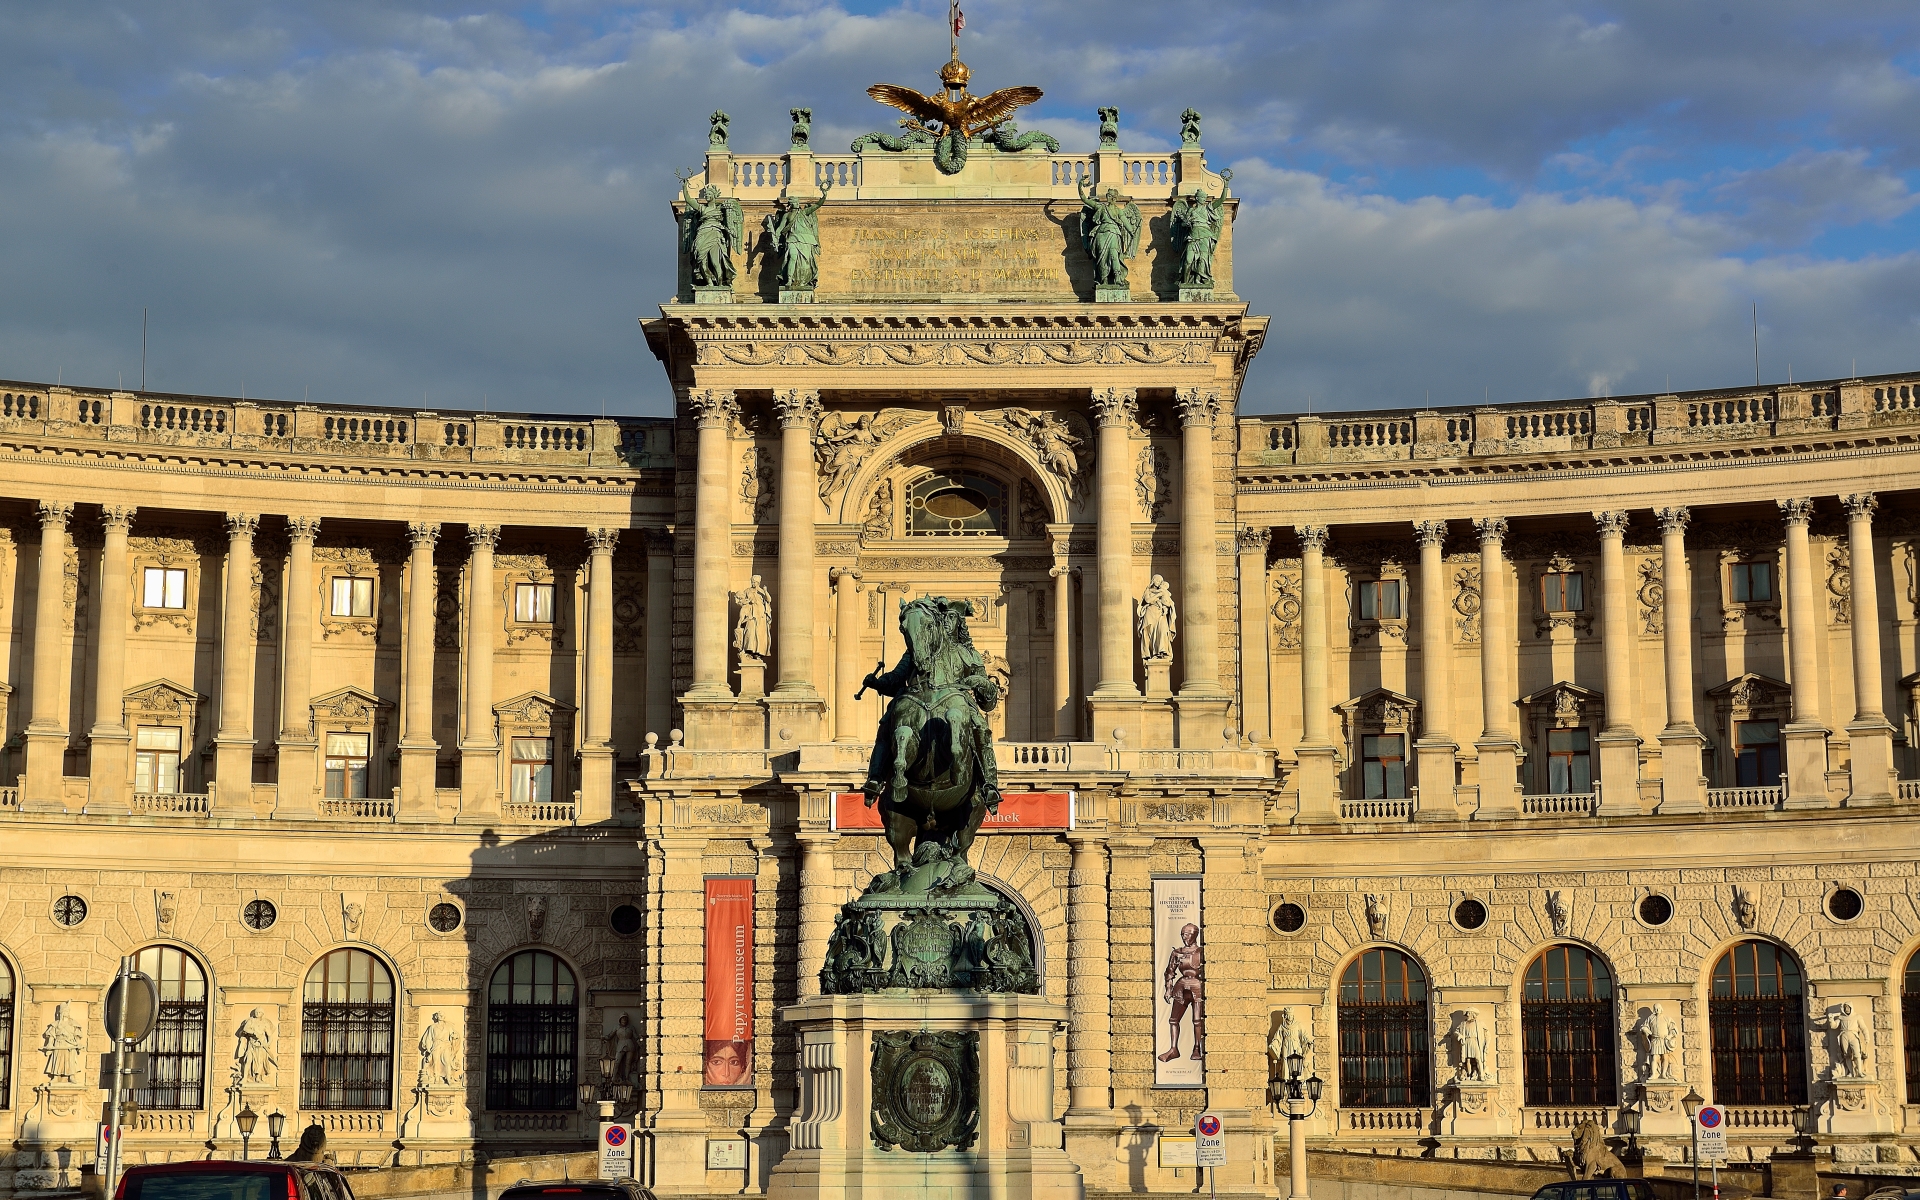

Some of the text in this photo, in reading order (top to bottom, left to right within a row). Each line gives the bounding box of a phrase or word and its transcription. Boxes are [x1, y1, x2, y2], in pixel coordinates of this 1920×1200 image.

[964, 228, 1039, 240] IOSEPHVS
[870, 248, 910, 260] NOVI
[852, 269, 941, 280] EXSTRVXIT
[951, 269, 961, 280] A
[971, 268, 982, 280] D
[983, 812, 1020, 823] othek
[732, 924, 748, 1043] Papyrusmuseum
[1702, 1130, 1721, 1139] Zone
[1201, 1137, 1220, 1147] Zone
[607, 1148, 625, 1157] Zone
